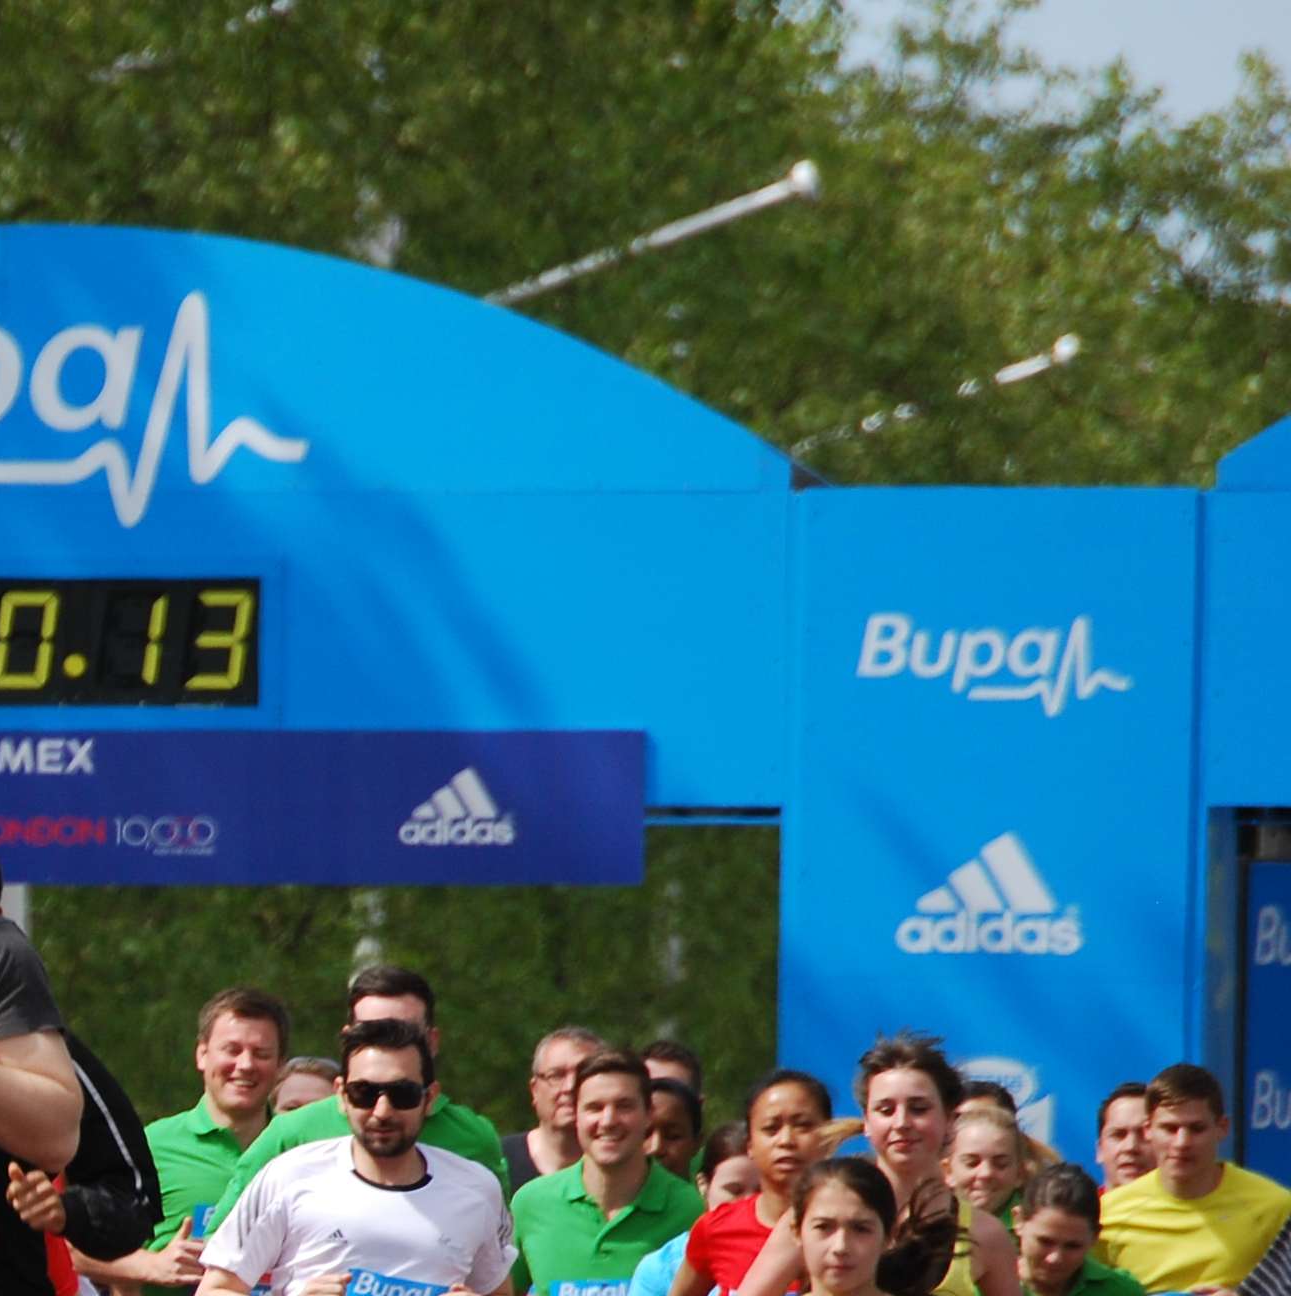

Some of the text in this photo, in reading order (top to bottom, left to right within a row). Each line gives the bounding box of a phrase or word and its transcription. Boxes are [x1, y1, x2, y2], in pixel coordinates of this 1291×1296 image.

[855, 612, 1062, 701] Bupa
[398, 814, 515, 846] adidas
[895, 912, 1083, 956] adidas
